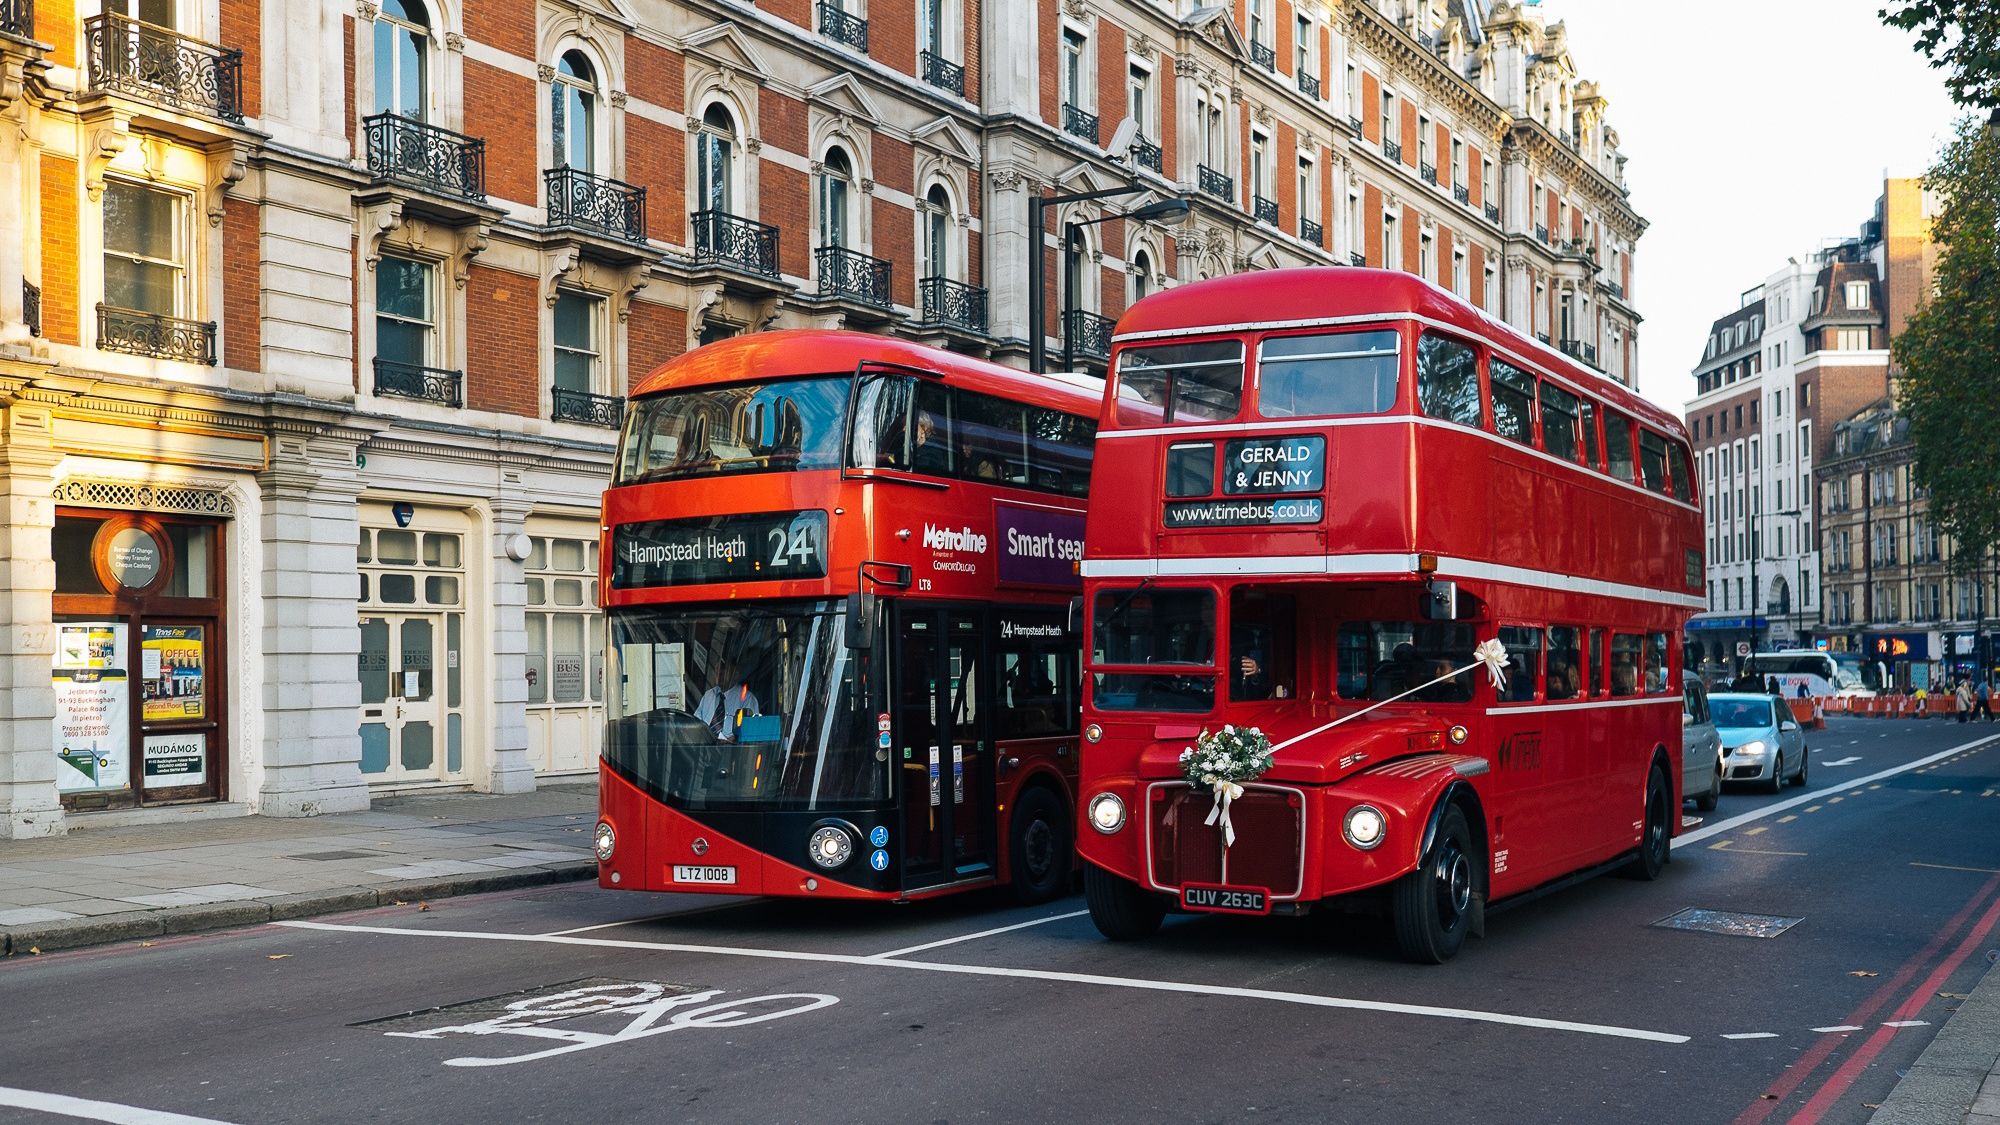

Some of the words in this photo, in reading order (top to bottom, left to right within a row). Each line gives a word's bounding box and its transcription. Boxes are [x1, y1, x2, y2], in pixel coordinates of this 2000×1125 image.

[1240, 446, 1310, 463] GERALD
[1235, 472, 1248, 487] &
[1253, 470, 1313, 487] JENNY
[1172, 499, 1318, 522] www.timebus.co.uk
[923, 522, 987, 553] Metroline
[1007, 527, 1054, 559] Smart
[136, 547, 153, 555] Change
[629, 537, 701, 568] Hampstead
[707, 534, 746, 559] Heath
[768, 527, 813, 566] 24
[919, 579, 932, 590] LT8
[1000, 620, 1012, 638] 24
[1014, 625, 1044, 637] Hampstead
[1045, 625, 1062, 636] Heath
[166, 648, 198, 658] OFFICE
[360, 654, 386, 664] BUS
[404, 654, 430, 664] BUS
[556, 664, 580, 672] BUS
[78, 696, 116, 704] Buckingham
[148, 742, 198, 754] MUDÁMOS
[680, 867, 702, 881] LTZ
[703, 868, 728, 881] 1008
[1186, 889, 1217, 905] CUV
[1221, 892, 1263, 909] 263C
